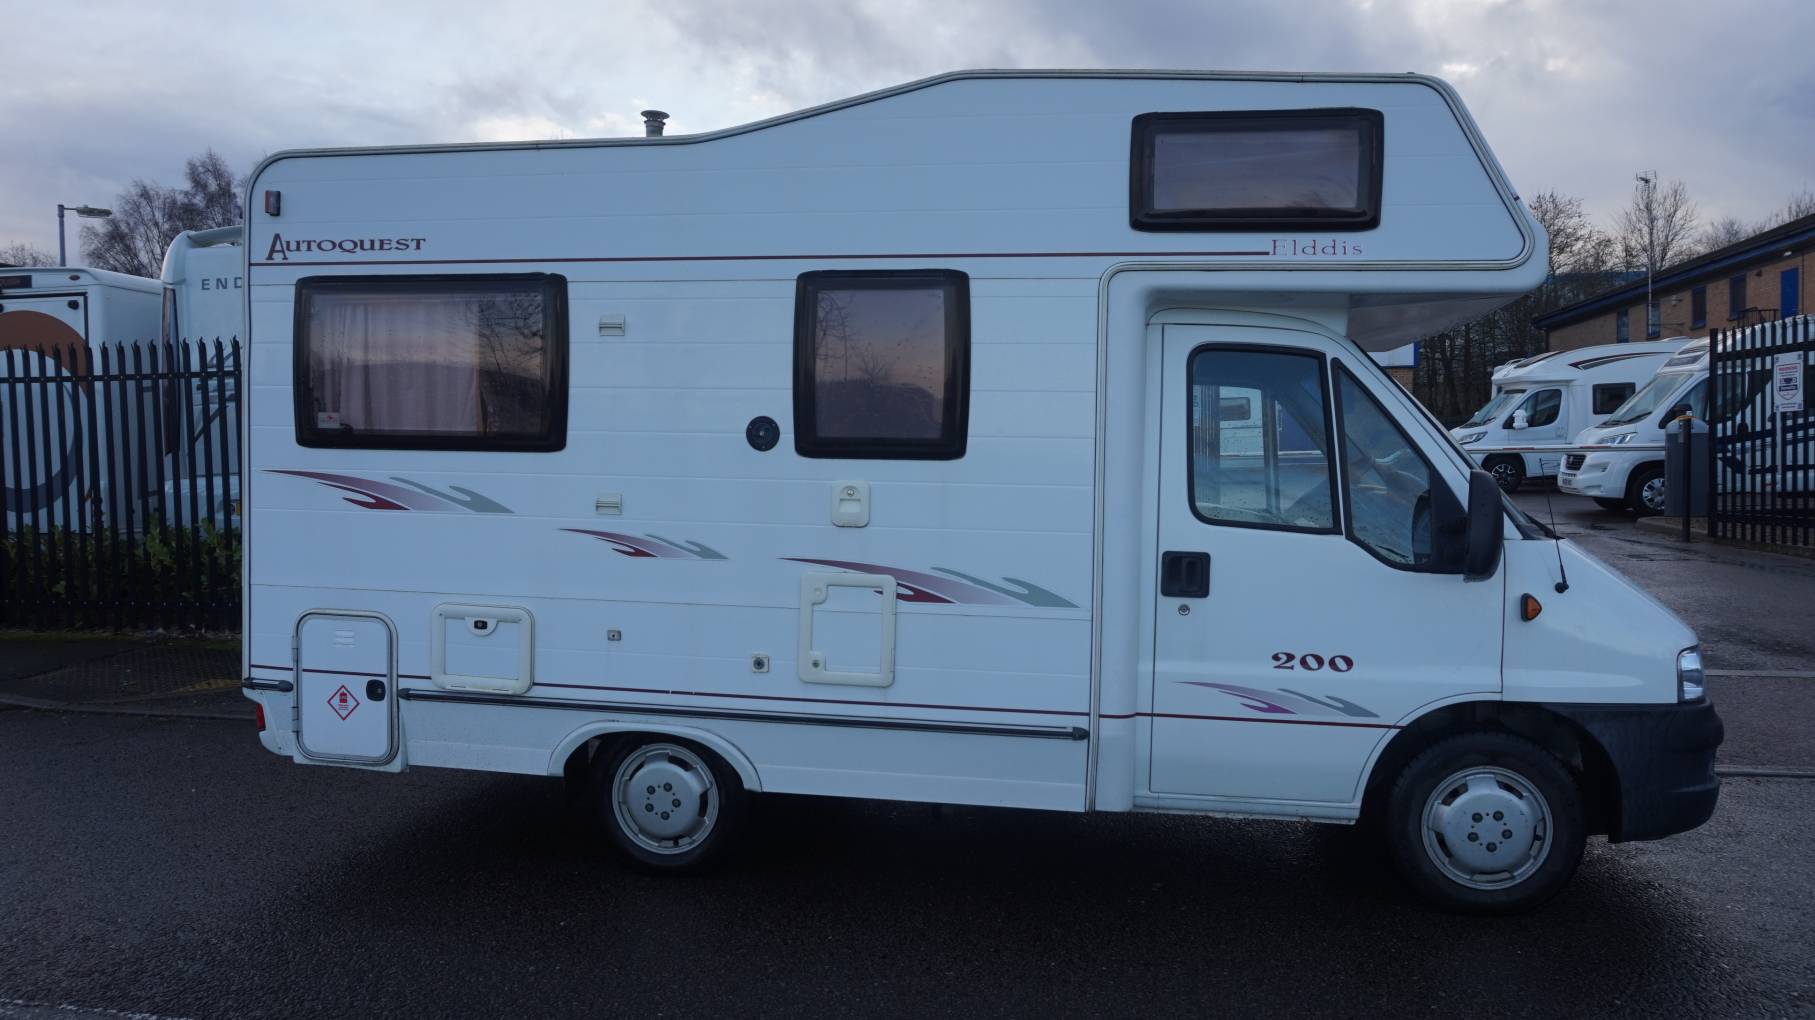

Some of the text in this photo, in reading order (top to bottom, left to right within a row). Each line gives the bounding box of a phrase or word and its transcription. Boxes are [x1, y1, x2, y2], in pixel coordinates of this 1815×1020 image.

[266, 233, 426, 260] AUTOQUEST
[1271, 239, 1362, 256] Elddis
[1271, 651, 1354, 673] 200
